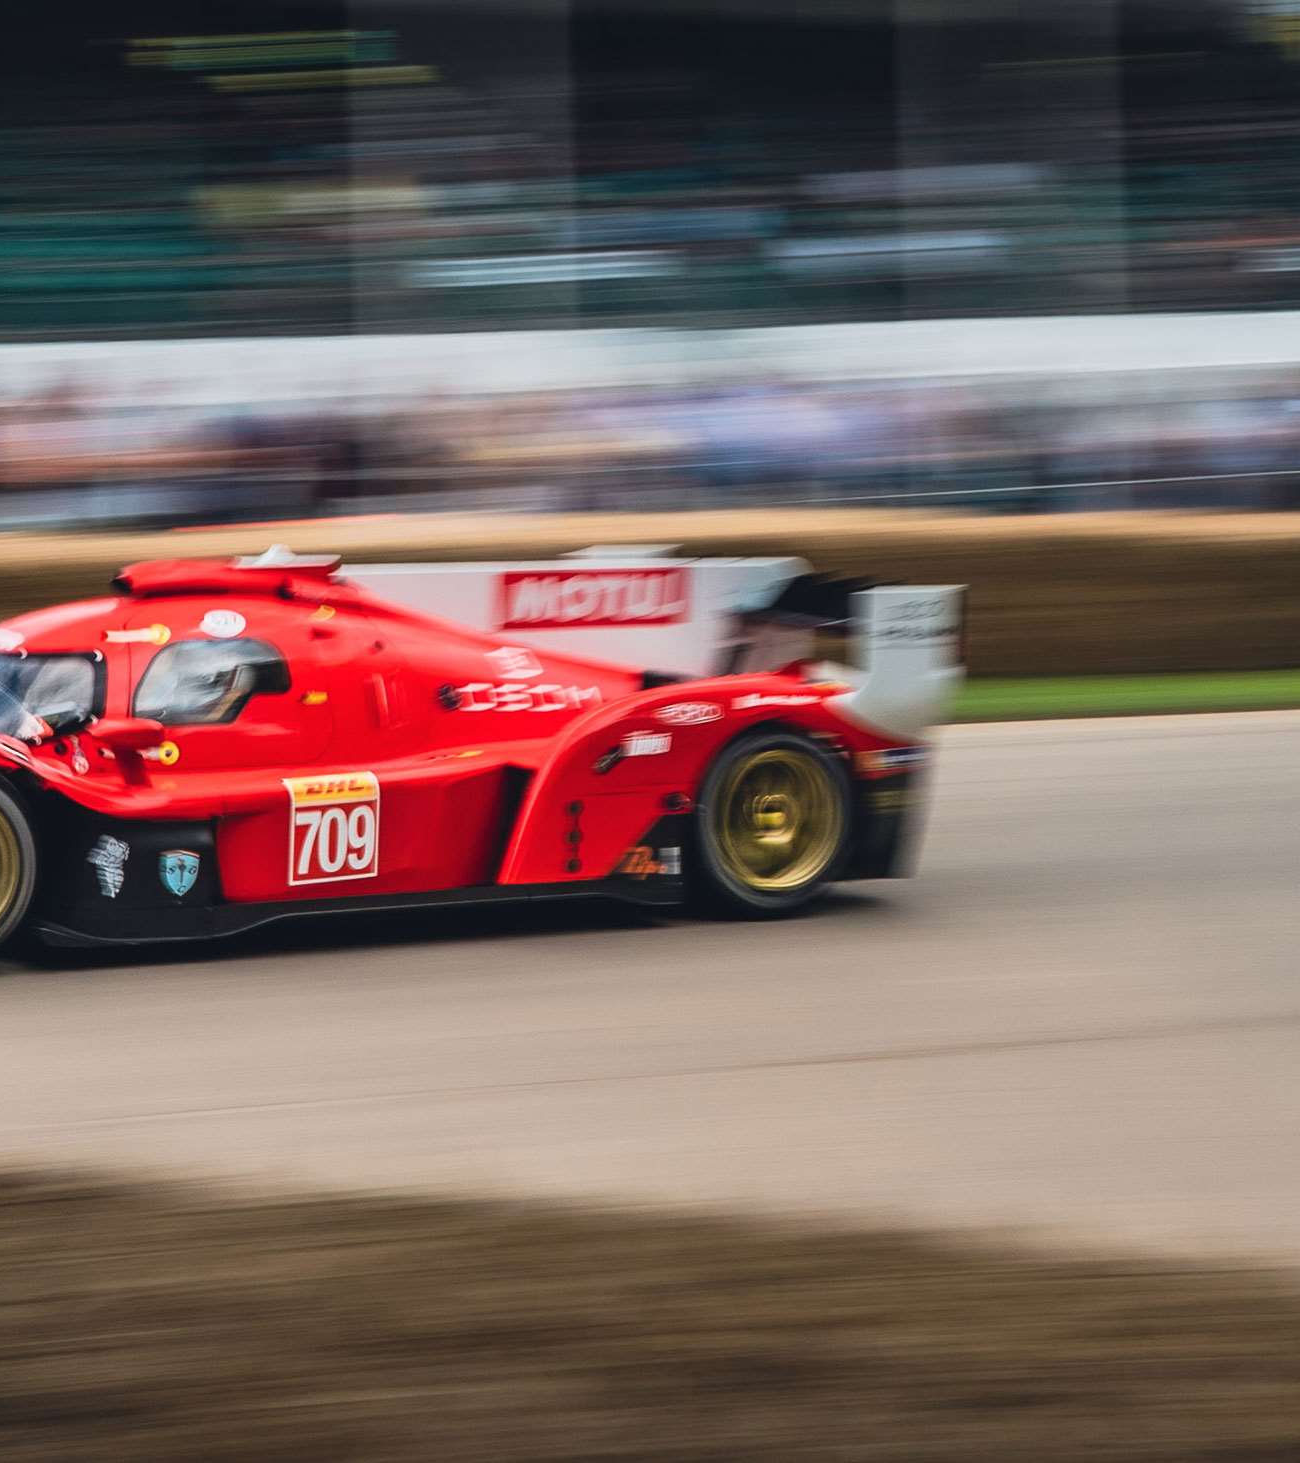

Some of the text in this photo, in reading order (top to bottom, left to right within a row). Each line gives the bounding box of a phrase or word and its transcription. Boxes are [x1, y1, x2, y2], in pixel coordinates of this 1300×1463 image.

[508, 572, 685, 624] MOTUL
[303, 779, 365, 796] DHL
[295, 804, 376, 875] 709
